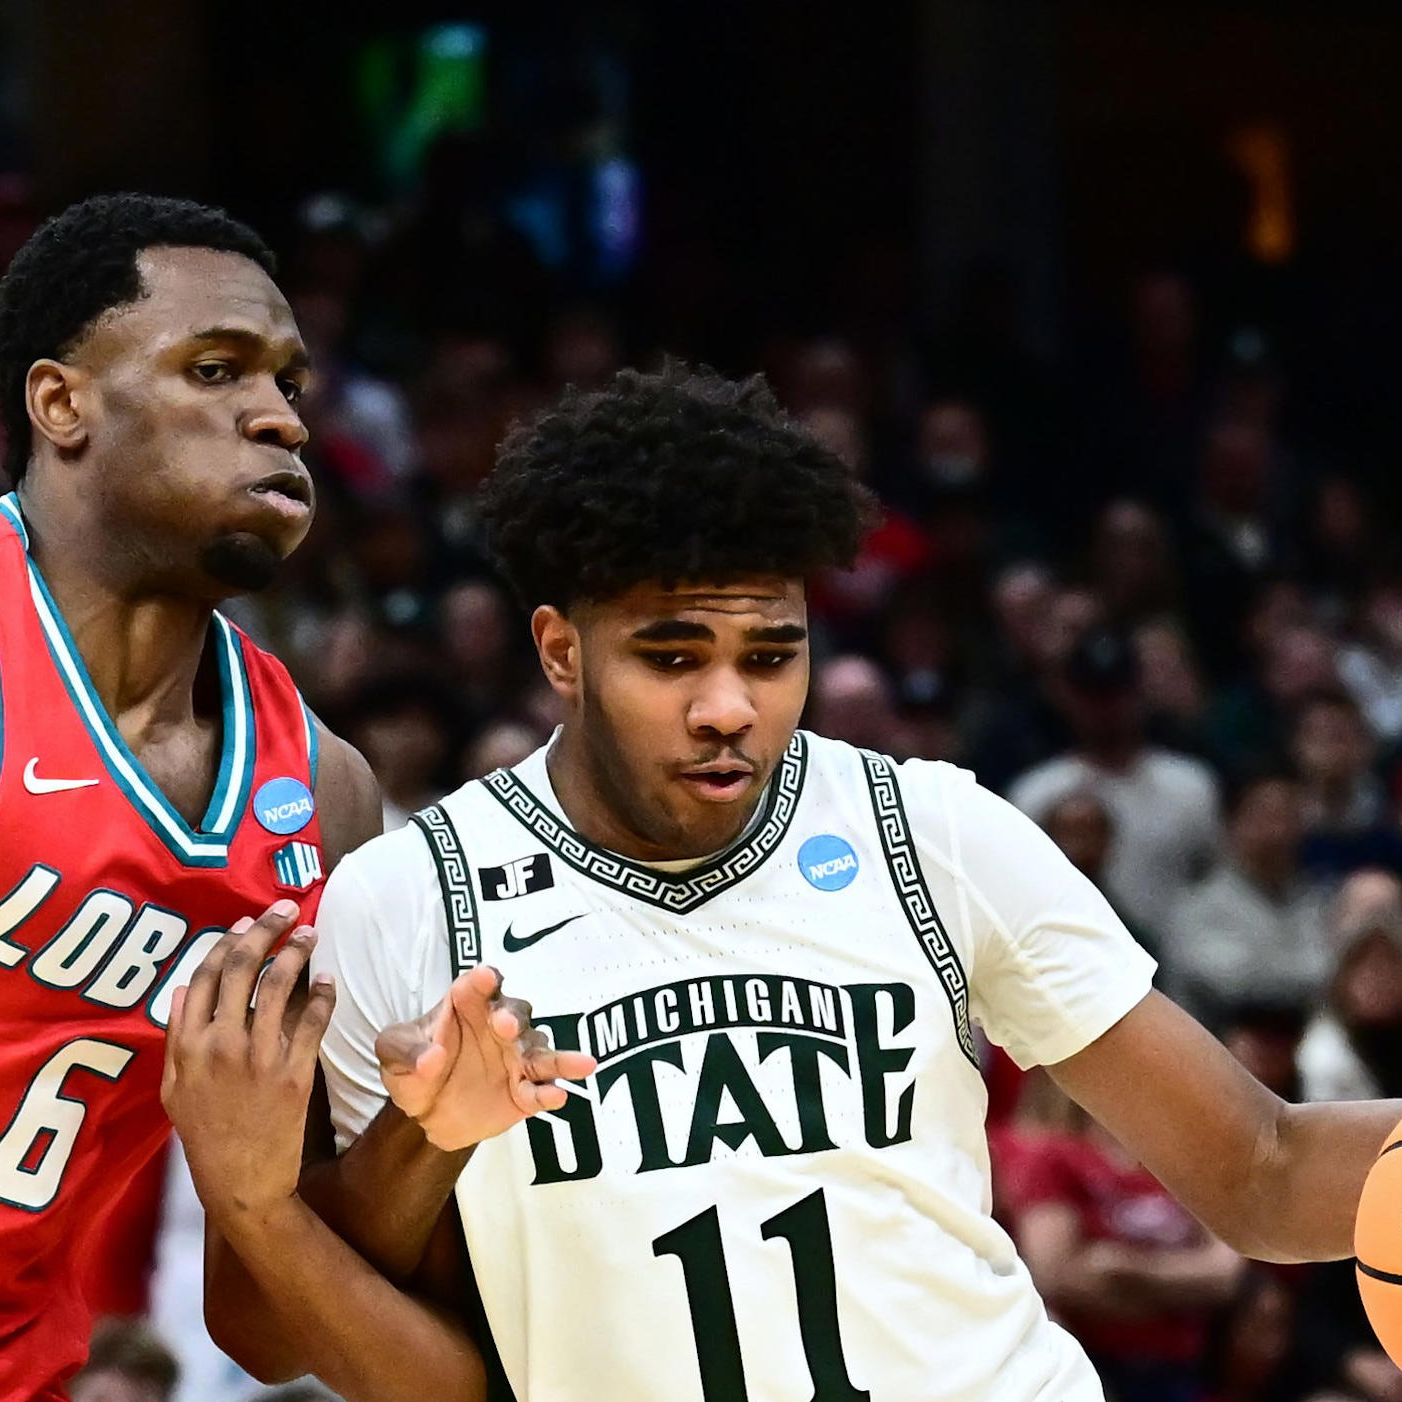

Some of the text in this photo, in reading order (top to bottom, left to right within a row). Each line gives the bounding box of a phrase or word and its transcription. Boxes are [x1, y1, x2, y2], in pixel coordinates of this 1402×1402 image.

[263, 798, 313, 825] NCAA
[495, 856, 536, 900] JF
[809, 853, 857, 881] NCAA
[596, 978, 838, 1059] MICHIGAN
